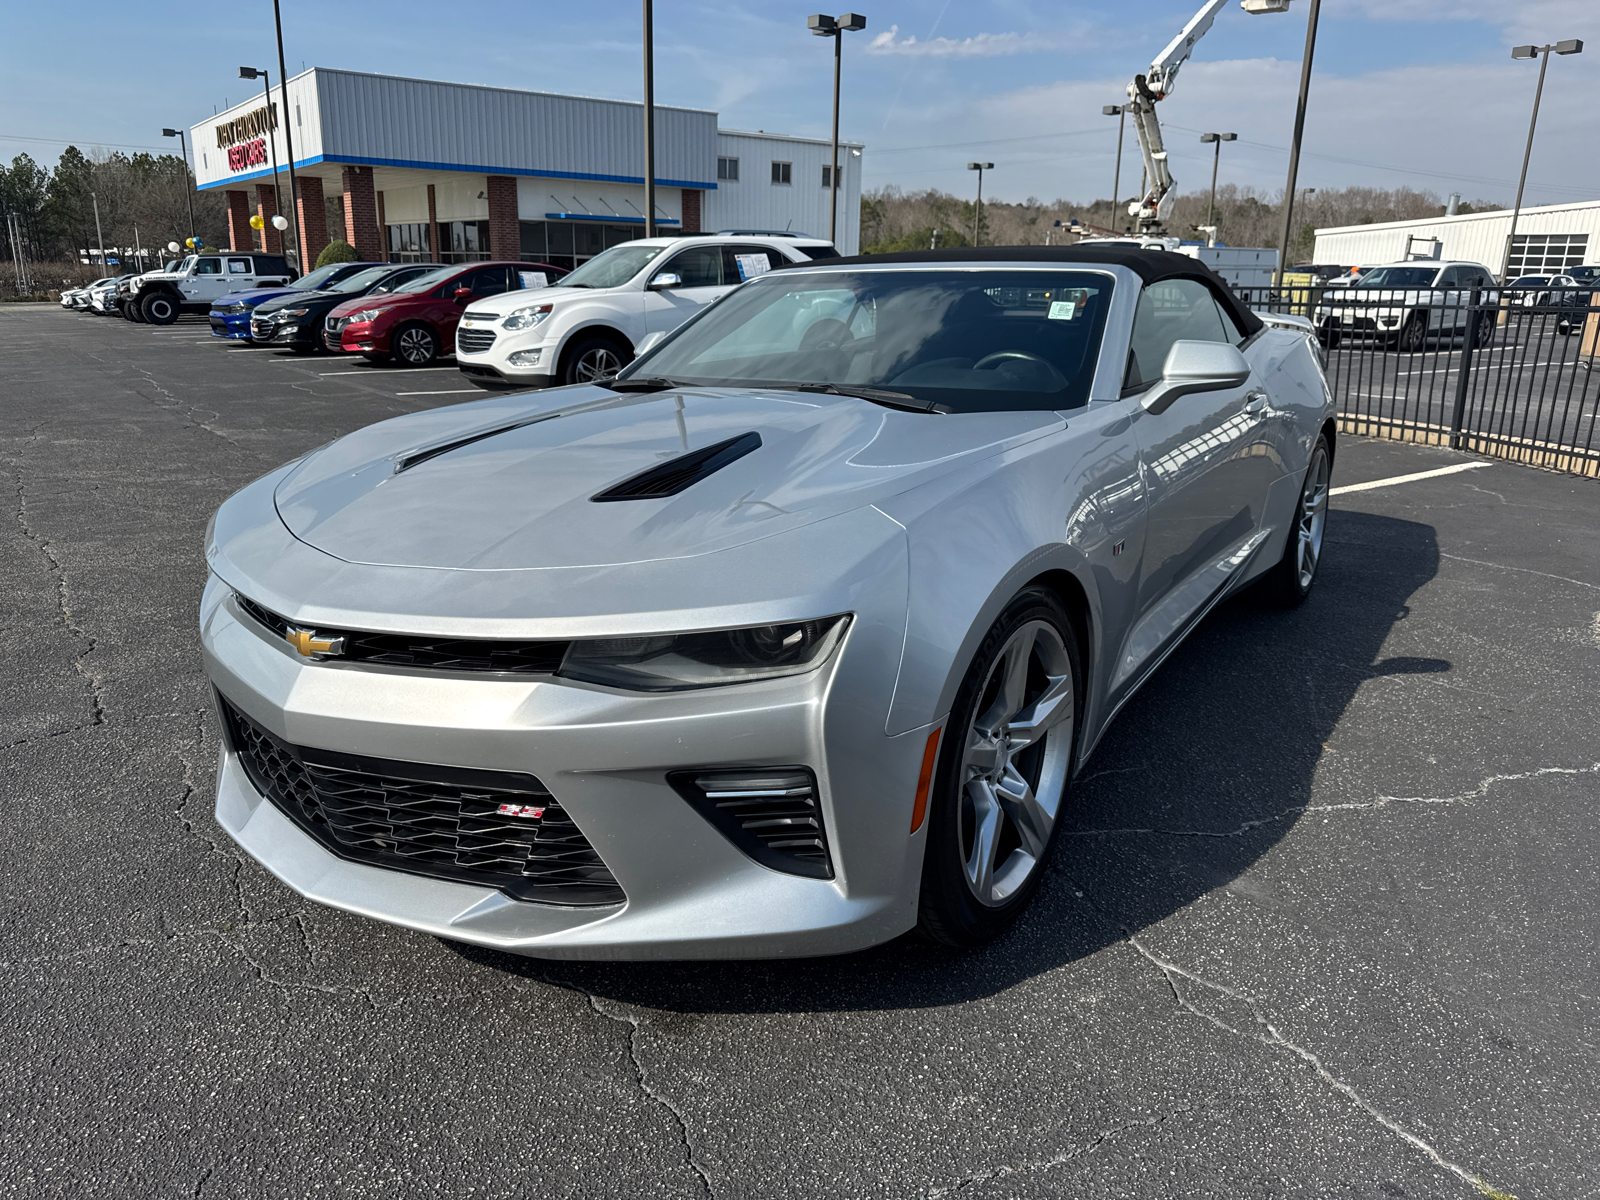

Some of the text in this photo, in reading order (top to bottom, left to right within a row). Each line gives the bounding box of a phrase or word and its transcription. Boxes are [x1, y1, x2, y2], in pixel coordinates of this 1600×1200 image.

[215, 102, 279, 149] JOHN THORNTON
[227, 138, 267, 172] USED CARS
